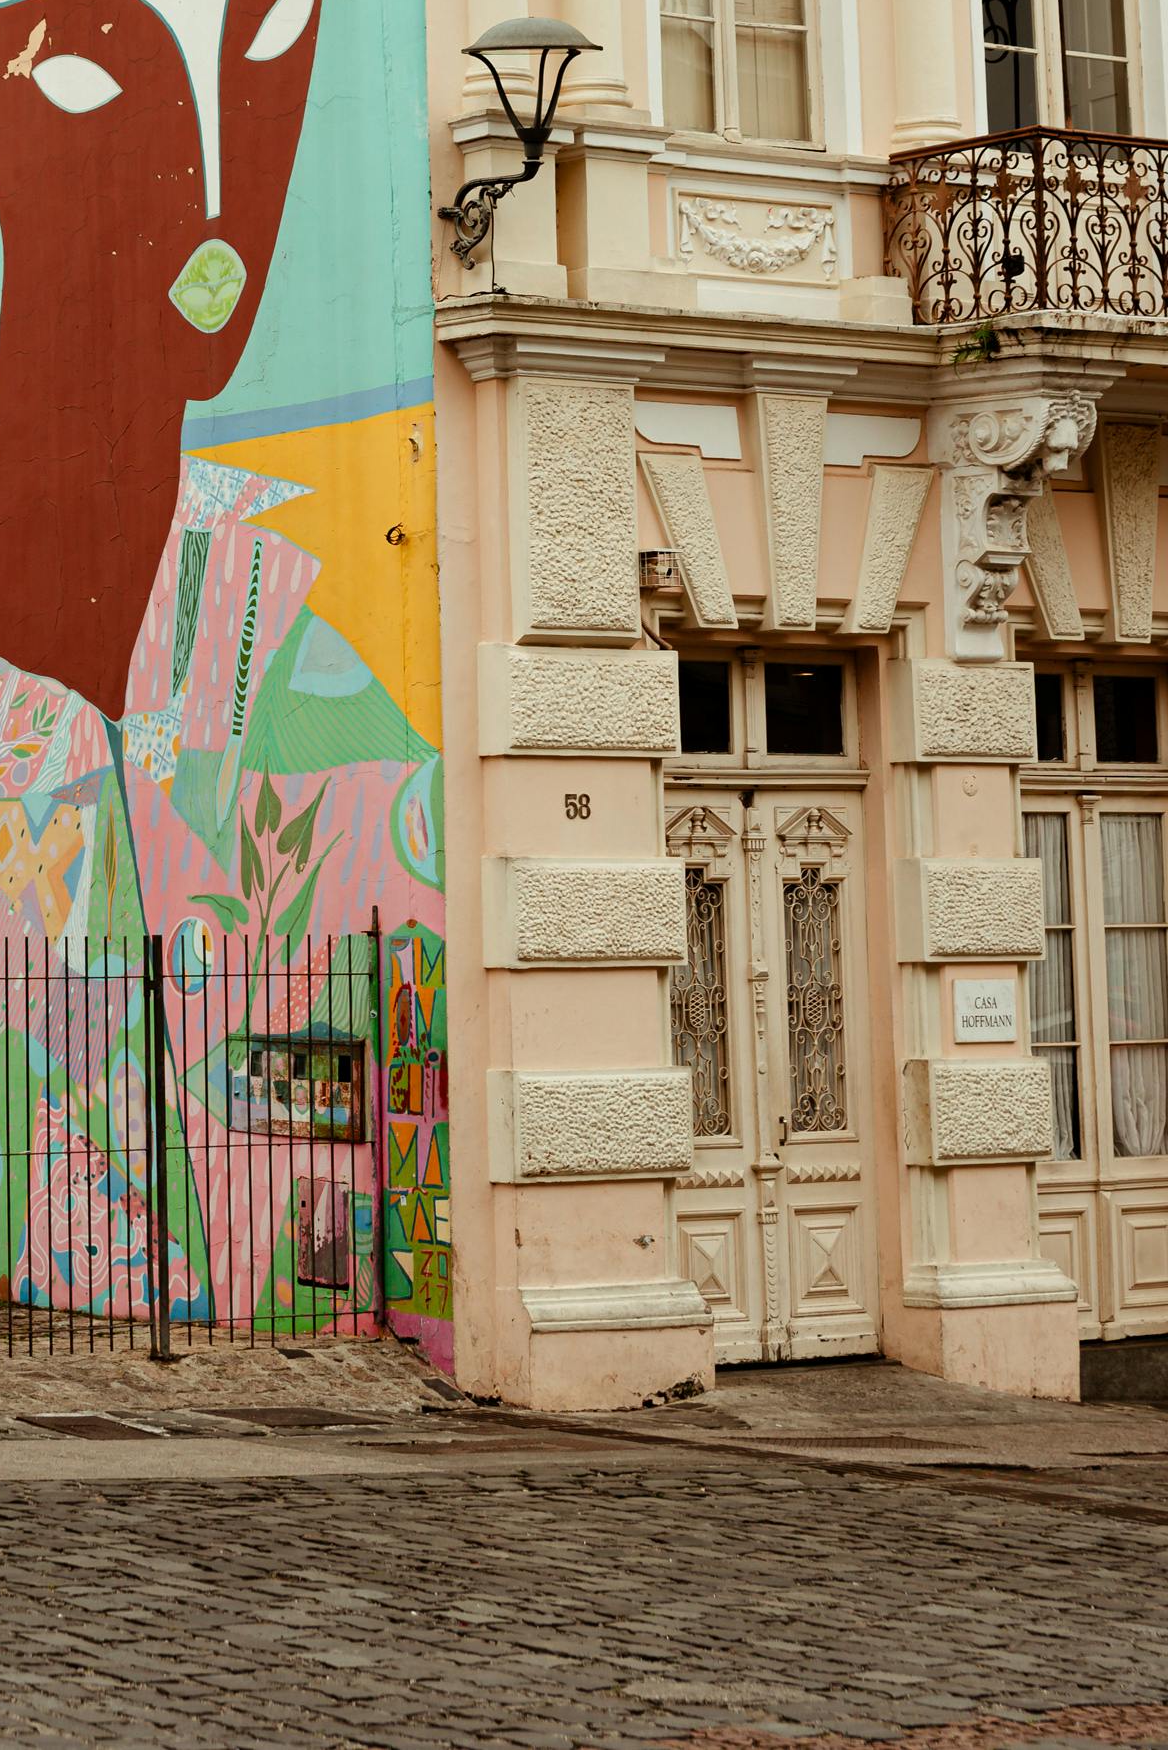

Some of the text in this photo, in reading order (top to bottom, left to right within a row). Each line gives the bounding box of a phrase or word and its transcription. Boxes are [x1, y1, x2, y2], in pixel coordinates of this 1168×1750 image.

[564, 793, 591, 820] 58
[974, 996, 998, 1010] CASA
[961, 1015, 1013, 1028] HOFFMANN
